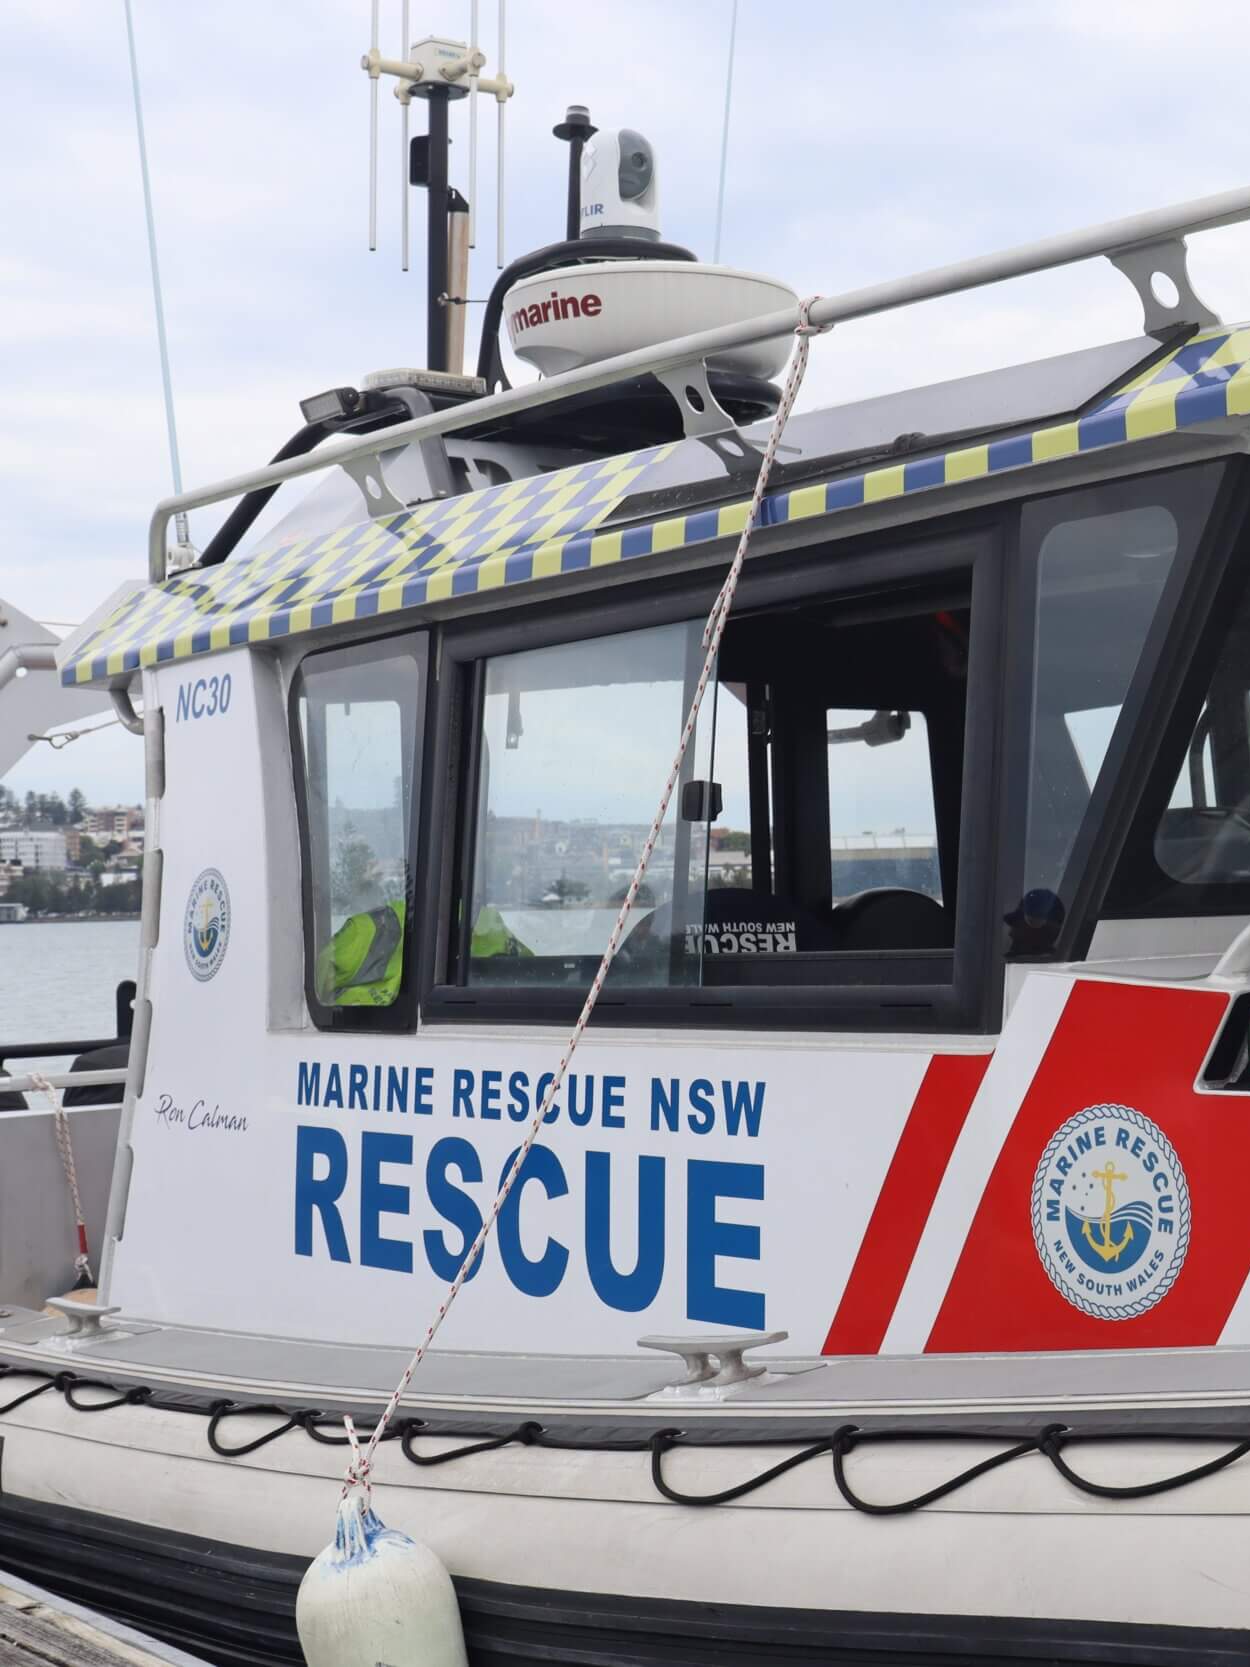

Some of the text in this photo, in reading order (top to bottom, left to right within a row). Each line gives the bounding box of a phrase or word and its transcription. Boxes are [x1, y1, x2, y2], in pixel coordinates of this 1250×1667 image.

[507, 291, 603, 344] marine
[176, 673, 231, 723] NC30
[210, 879, 226, 933] RESCUE
[723, 921, 762, 933] SOUTH
[766, 921, 796, 933] NEW
[154, 1093, 248, 1132] Ron Calman
[297, 1061, 766, 1138] MARINE RESCUE NSW
[1046, 1126, 1174, 1236] MARINE RESCUE
[294, 1124, 766, 1331] RESCUE
[1053, 1239, 1165, 1297] NEW SOUTH WALES
